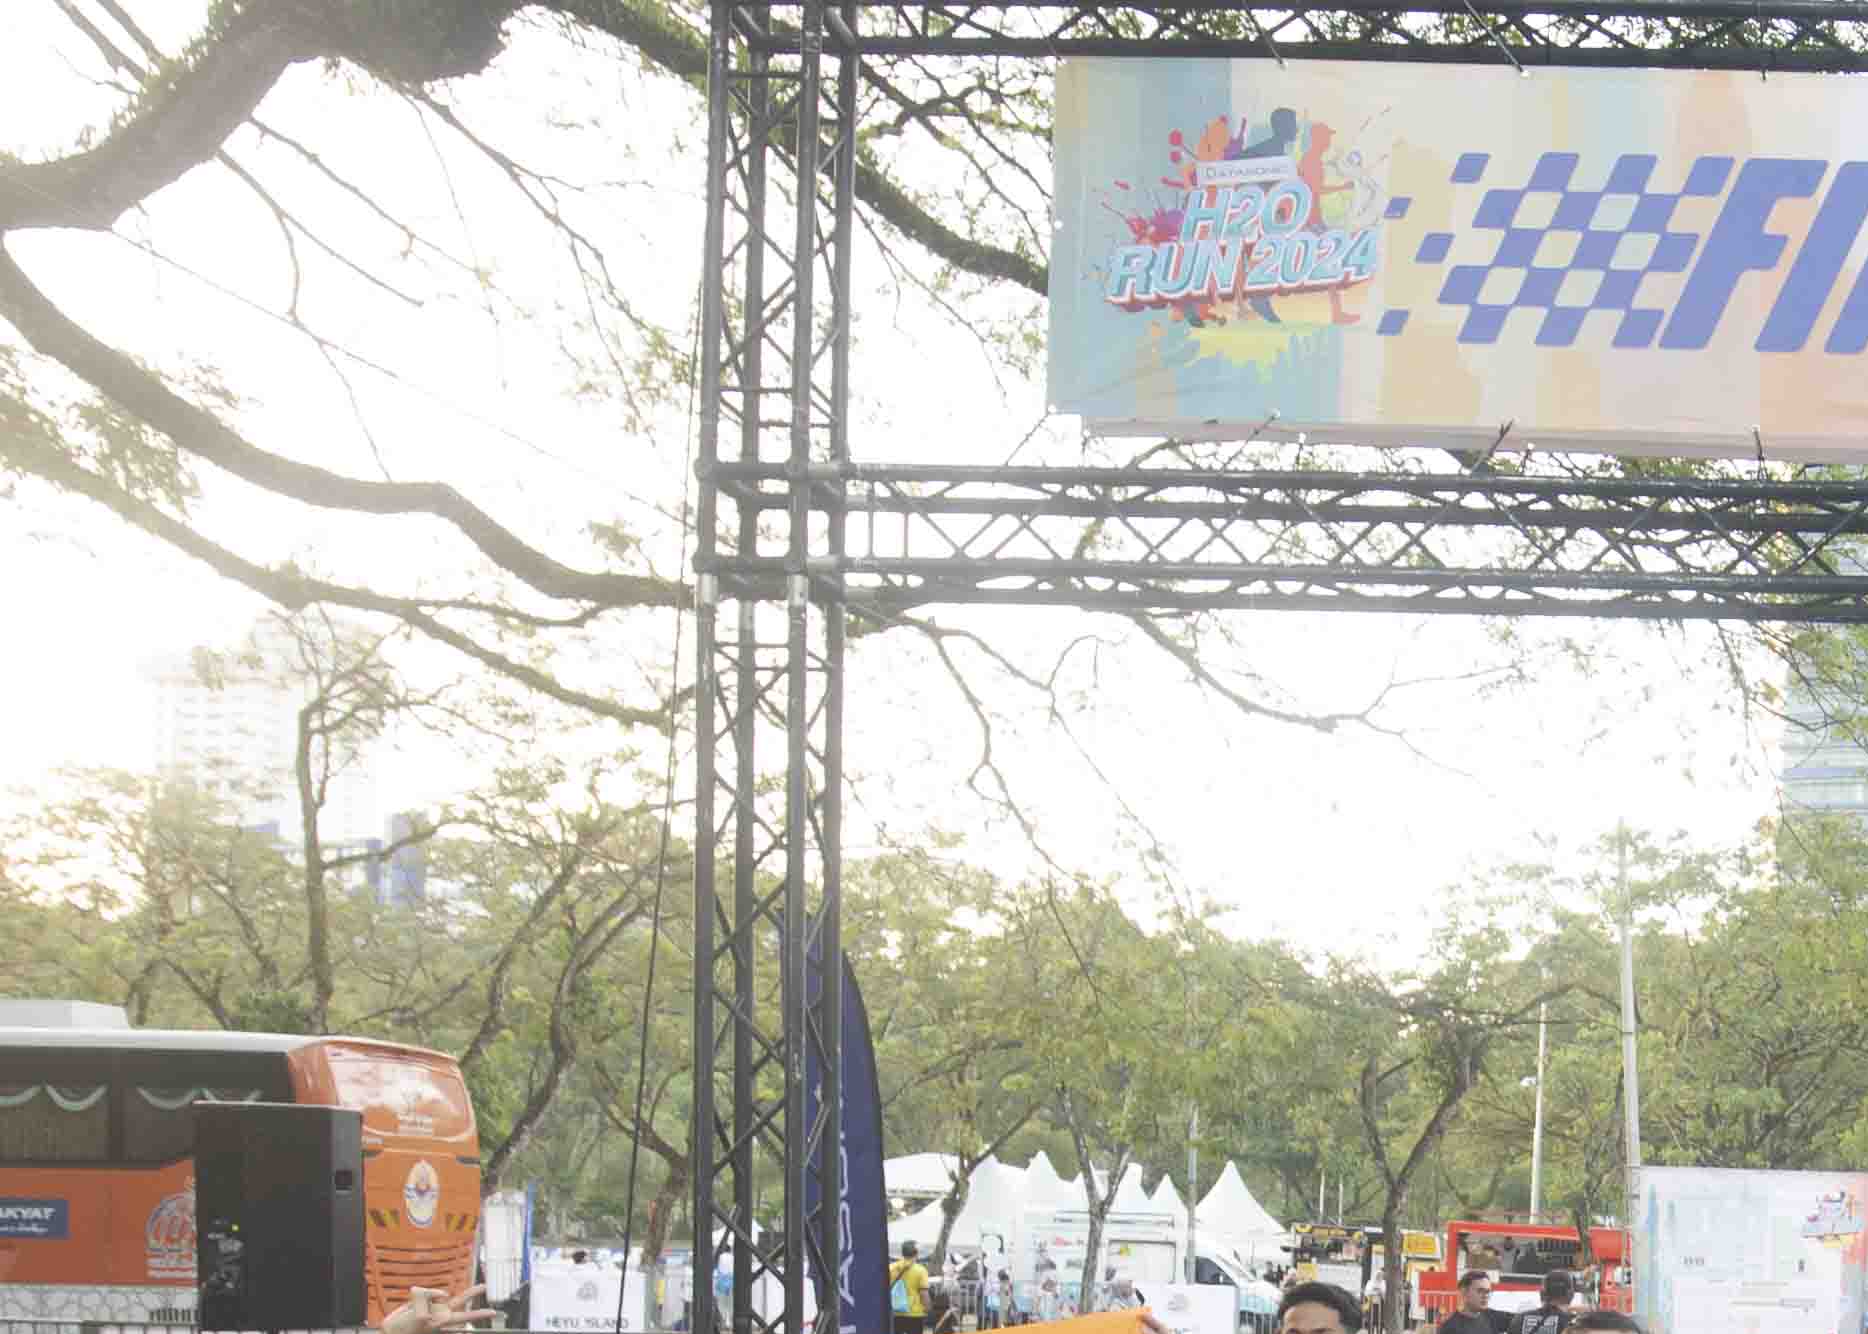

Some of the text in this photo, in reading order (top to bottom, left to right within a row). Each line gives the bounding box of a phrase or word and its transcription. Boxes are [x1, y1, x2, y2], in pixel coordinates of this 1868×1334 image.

[1181, 181, 1312, 243] H2O
[1108, 230, 1378, 299] RUN 2024
